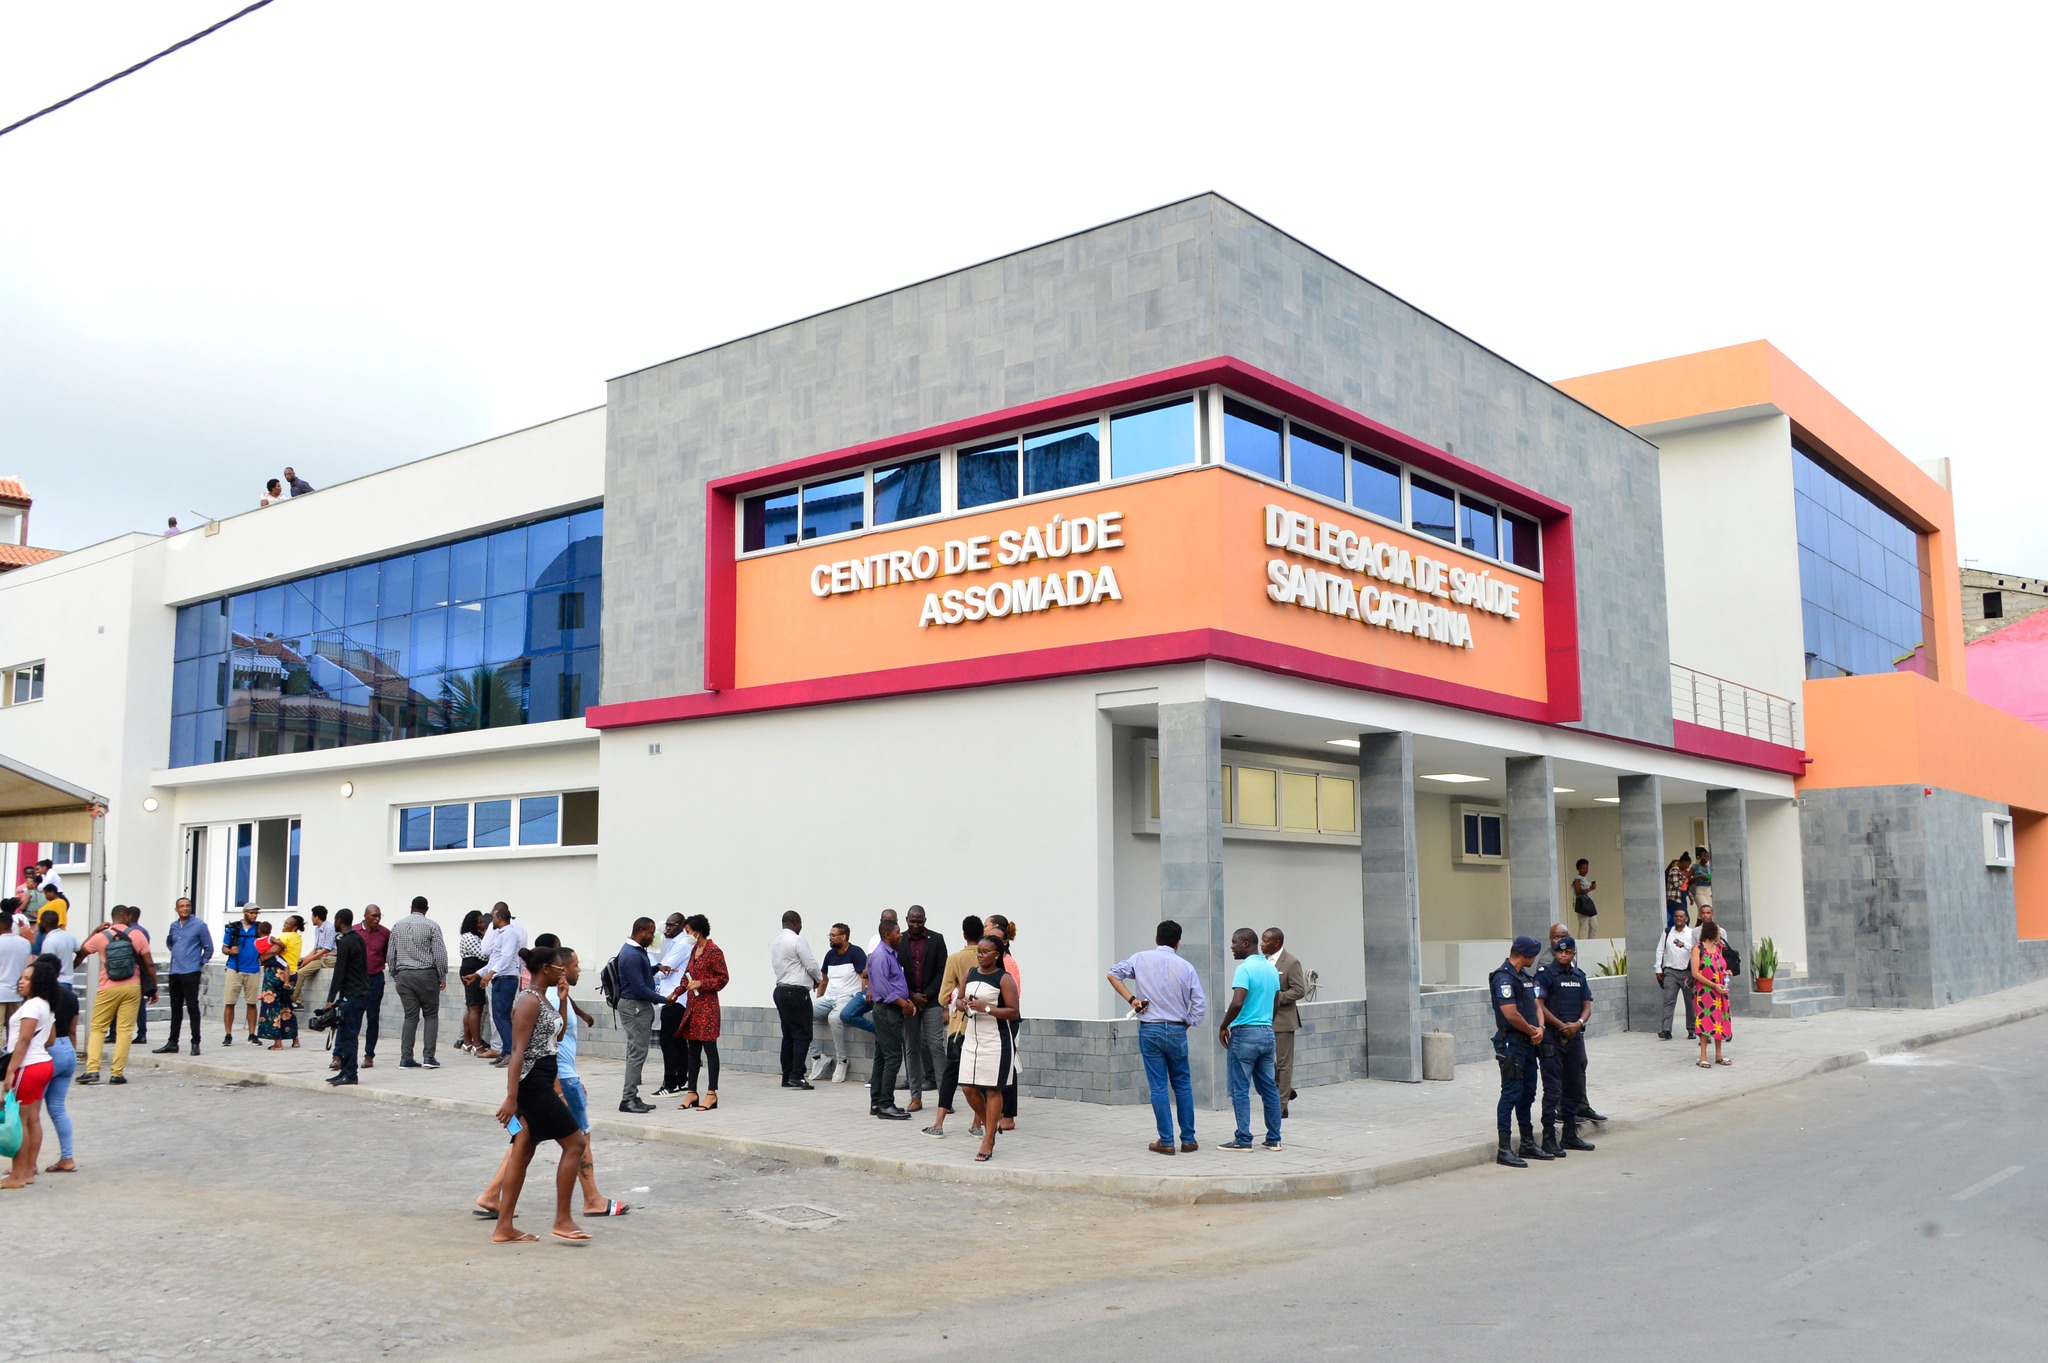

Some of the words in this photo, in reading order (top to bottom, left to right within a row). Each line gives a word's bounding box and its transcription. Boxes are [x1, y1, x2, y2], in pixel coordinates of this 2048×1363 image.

[810, 545, 938, 598] CENTRO
[944, 535, 991, 575] DE
[996, 511, 1126, 566] SAÚDE
[918, 565, 1123, 628] ASSOMADA
[1264, 503, 1416, 588] DELEGACIA
[1415, 554, 1450, 600] DE
[1449, 567, 1521, 620] SAÚDE
[1266, 559, 1360, 620] SANTA
[1359, 585, 1475, 650] CATARINA
